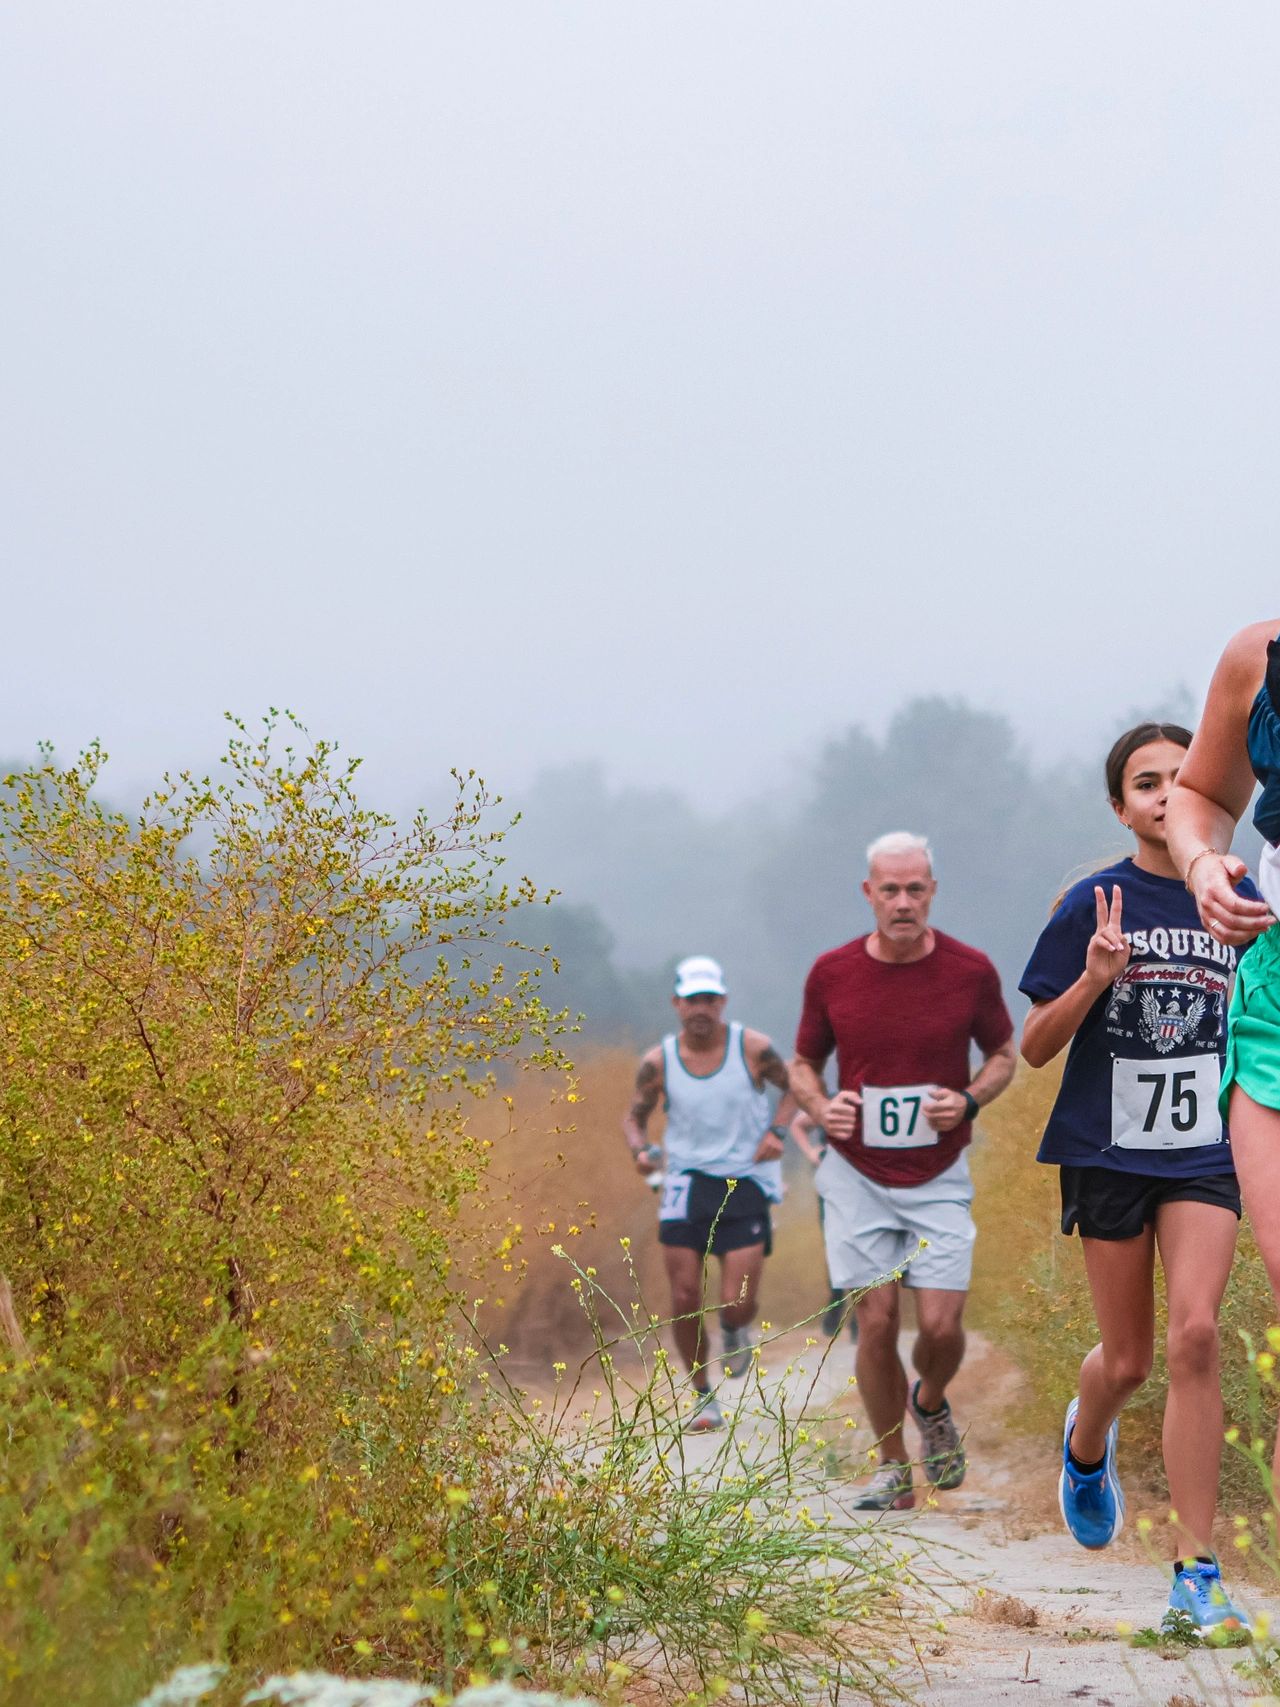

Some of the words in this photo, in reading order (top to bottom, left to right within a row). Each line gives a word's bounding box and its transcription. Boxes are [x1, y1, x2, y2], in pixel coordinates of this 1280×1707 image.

[1123, 927, 1237, 970] SQUEDA
[880, 1096, 921, 1136] 67
[1137, 1070, 1198, 1133] 75
